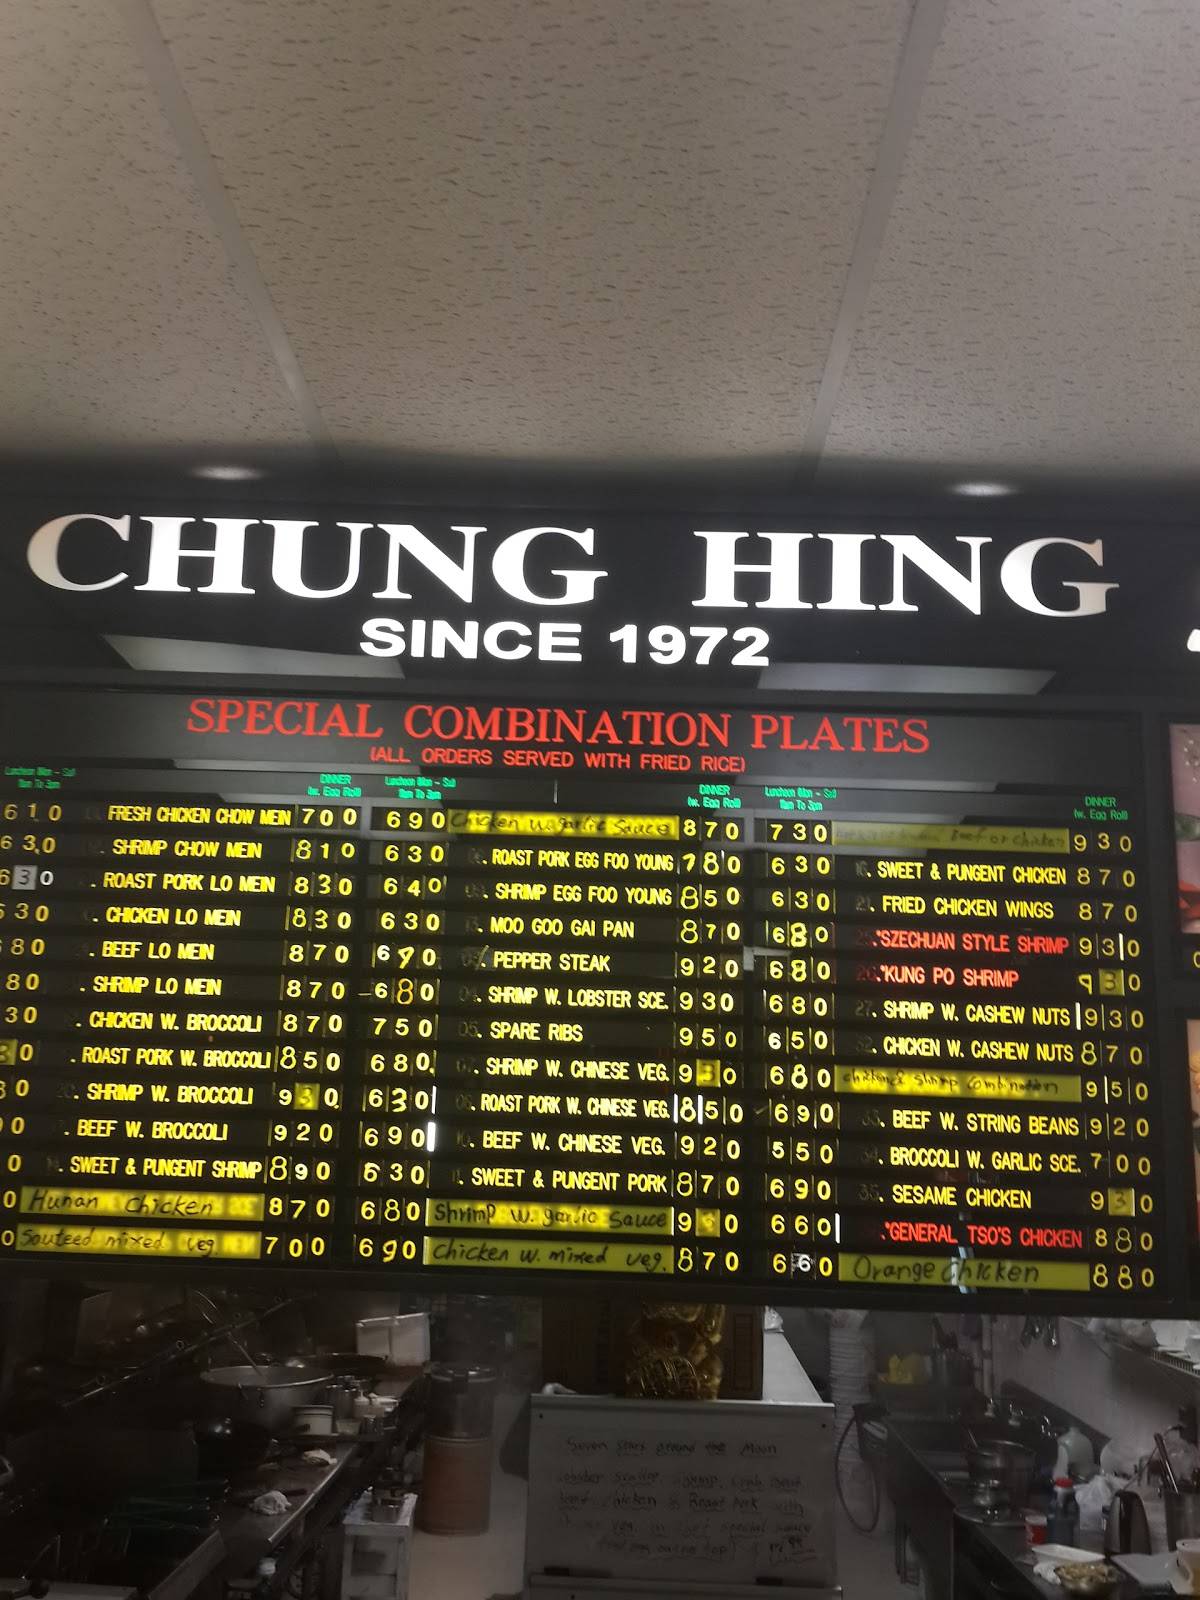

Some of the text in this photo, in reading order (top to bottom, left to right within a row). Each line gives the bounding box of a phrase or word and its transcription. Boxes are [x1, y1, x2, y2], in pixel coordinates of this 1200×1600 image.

[29, 514, 1118, 616] CHUNG HING
[360, 618, 769, 666] SINCE 1972
[187, 699, 929, 753] SPECIAL COMBINATION PLATES
[369, 746, 745, 772] (ALL ORDERS SERVED WITH FRIED RICE)
[320, 774, 351, 784] DINNER
[699, 784, 730, 795] DINNER
[1085, 796, 1116, 807] DINNER
[108, 806, 152, 821] FRESH
[157, 807, 210, 823] CHICKEN
[216, 808, 255, 824] CHOW
[113, 839, 168, 855] SHRIMP
[174, 841, 220, 857] CHOW
[492, 849, 673, 871] ROAST PORK EGG FOO YOUNG
[103, 872, 157, 889] ROAST
[163, 874, 204, 890] PORK
[210, 875, 233, 891] LO
[878, 861, 1066, 884] SWEET & PUNGENT CHICKEN
[495, 883, 672, 905] SHRIMP EGG FOO YOUNG
[106, 907, 169, 924] CHICKEN
[175, 909, 198, 925] LO
[883, 895, 1054, 919] FRIED CHICKEN WINGS
[490, 917, 634, 938] MOO GOO GAI PAN
[102, 941, 142, 958] BEEF
[148, 943, 171, 959] LO
[963, 932, 1009, 952] STYLE
[1018, 934, 1069, 955] SHRIMP
[493, 951, 610, 972] PEPPER STEAK
[93, 976, 149, 993] SHRIMP
[155, 978, 178, 994] LO
[934, 968, 954, 984] PO
[963, 970, 1019, 988] SHRIMP
[488, 986, 668, 1009] SHRIMP W. LOBSTER SCE.
[89, 1011, 262, 1032] CHICKEN W. BROCCOLI
[884, 1000, 1070, 1026] SHRIMP W. CASHEW NUTS
[490, 1022, 583, 1042] SPARE RIBS
[82, 1047, 271, 1068] ROAST PORK W. BROCCOLI
[883, 1036, 1073, 1062] CHICKEN W. CASHEW NUTS
[486, 1057, 669, 1081] SHRIMP W. CHINESE VEG.
[87, 1083, 253, 1104] SHRIMP W. BROCCOLI
[481, 1094, 670, 1118] ROAST PORK W. CHINESE VEG.
[77, 1119, 228, 1140] BEEF W. BROCCOLI
[893, 1110, 1079, 1135] BEEF W. STRING BEANS
[483, 1131, 665, 1155] BEEF W. CHINESE VEG.
[70, 1156, 262, 1179] SWEET & PUNGENT SHRIMP
[890, 1147, 1081, 1172] BROCCOLI W. GARLIC SCE.
[472, 1167, 667, 1192] SWEET & PUNGENT PORK
[893, 1184, 1031, 1208] SESAME CHICKEN
[967, 1225, 1011, 1245] TSO'S
[1020, 1228, 1082, 1247] CHICKEN
[854, 1256, 935, 1280] Orange
